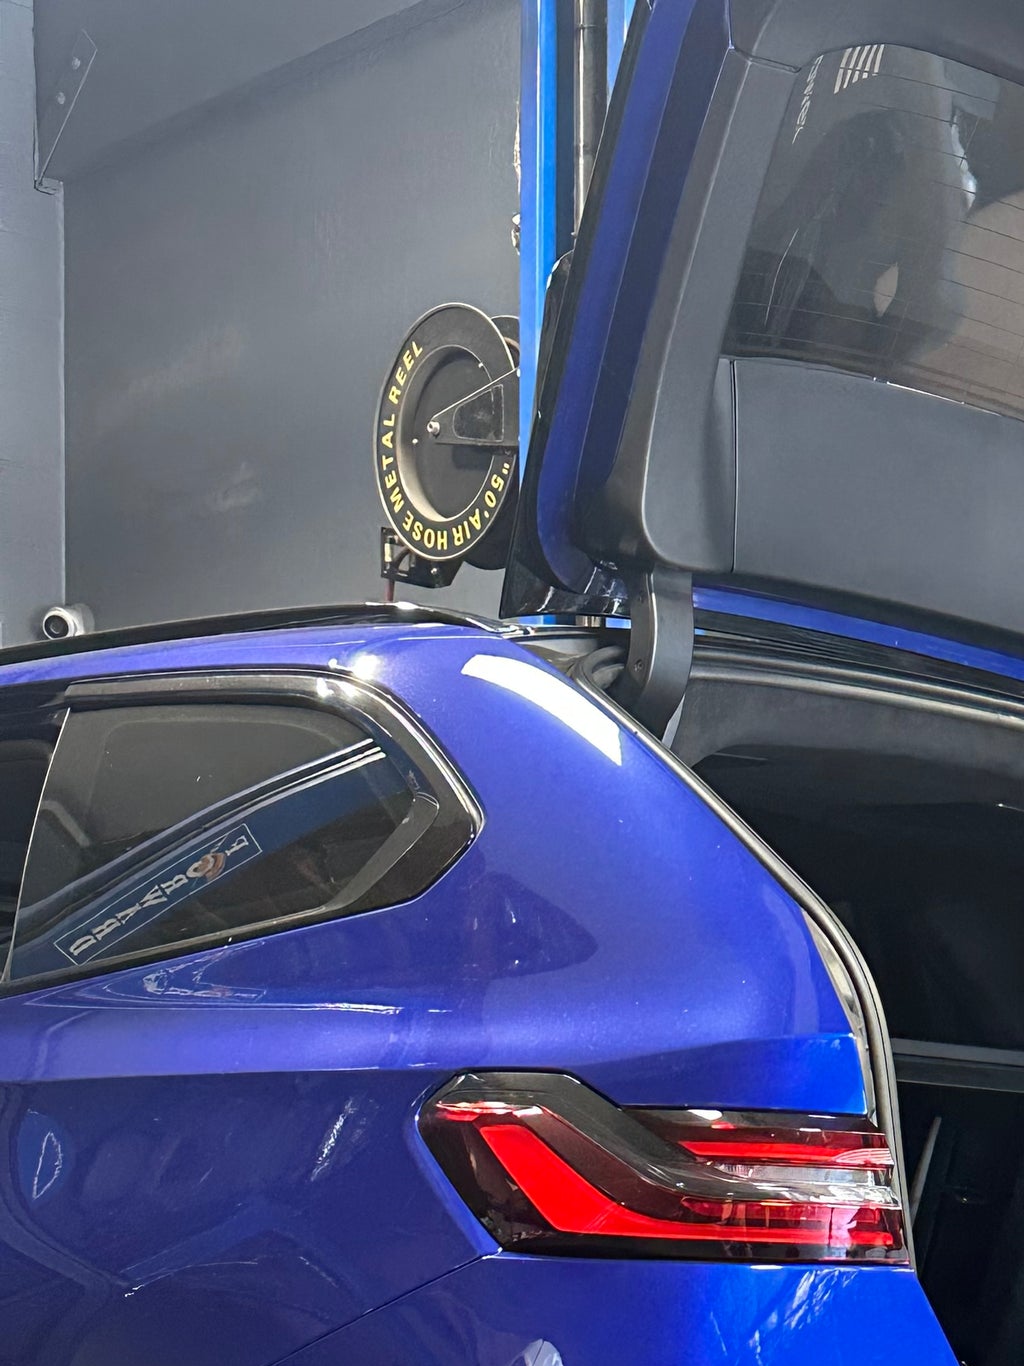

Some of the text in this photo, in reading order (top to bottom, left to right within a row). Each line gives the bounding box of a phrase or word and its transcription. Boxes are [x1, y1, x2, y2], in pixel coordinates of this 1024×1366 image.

[387, 340, 424, 405] REEL
[382, 412, 405, 514] METAL
[402, 510, 448, 551] HOSE
[453, 508, 482, 547] AIR
